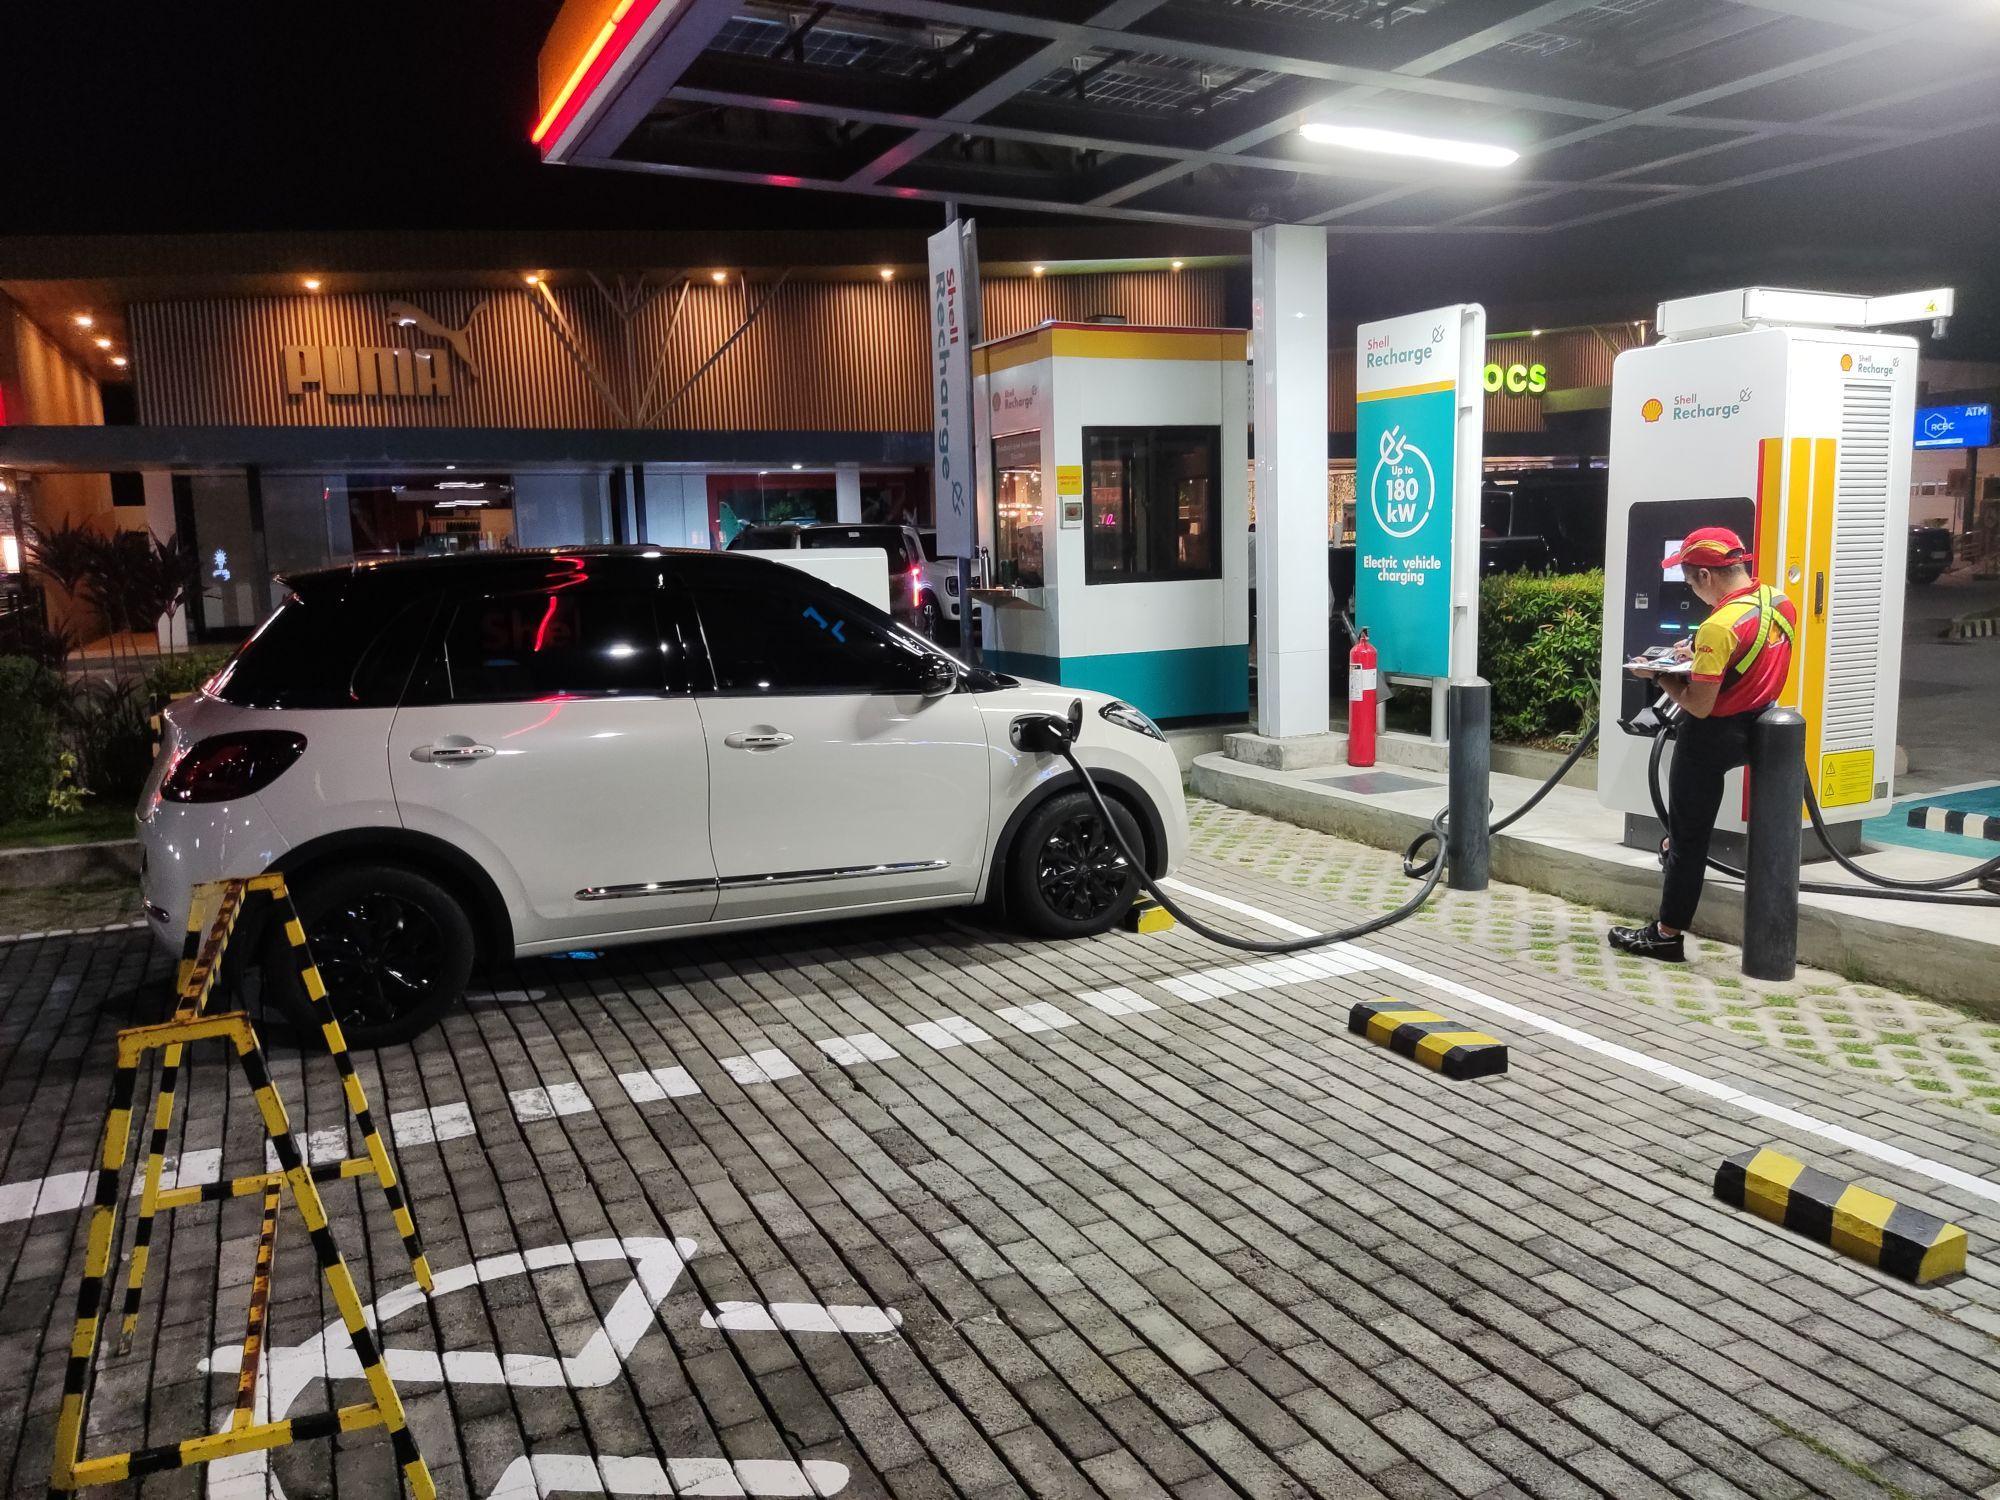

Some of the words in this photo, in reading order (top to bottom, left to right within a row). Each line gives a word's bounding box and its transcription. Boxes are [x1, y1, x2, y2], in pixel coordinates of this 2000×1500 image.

[946, 267, 959, 345] Shell
[1367, 335, 1390, 351] Shell
[1366, 346, 1433, 369] Recharge
[1858, 354, 1872, 363] Shell
[284, 345, 451, 397] PUMA
[935, 271, 951, 481] Recharge
[1857, 363, 1894, 377] Recharge
[1673, 393, 1697, 406] Shell
[1673, 403, 1740, 420] Recharge
[1964, 405, 1988, 417] ATM
[1931, 422, 1955, 432] RCBC
[1391, 465, 1403, 477] Up
[1404, 465, 1414, 475] to
[1386, 477, 1419, 501] 180
[1386, 503, 1416, 523] kW
[1363, 555, 1398, 569] Electric
[1402, 555, 1441, 570] vehicle
[1377, 568, 1425, 586] charging
